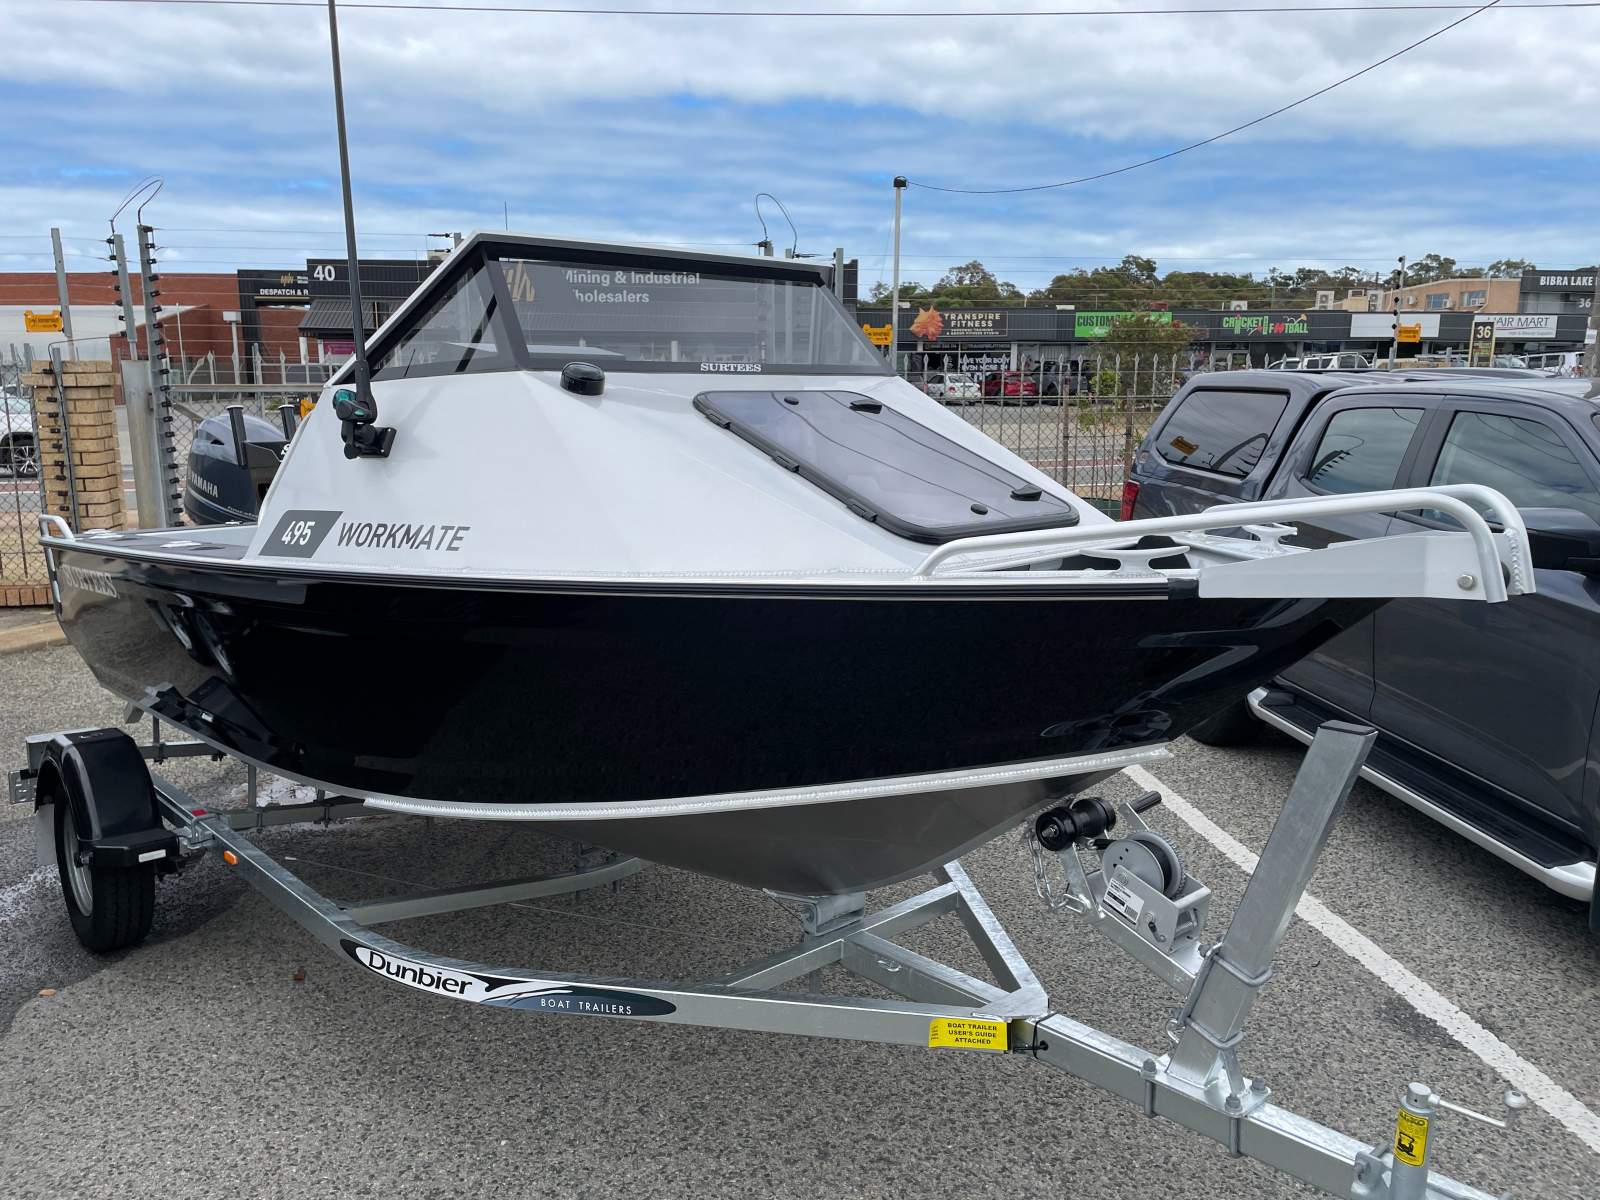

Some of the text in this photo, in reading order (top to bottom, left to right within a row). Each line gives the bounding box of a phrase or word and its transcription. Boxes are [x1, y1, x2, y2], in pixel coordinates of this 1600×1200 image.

[313, 265, 336, 281] 40
[615, 271, 627, 284] &
[631, 271, 700, 284] Industrial
[1540, 276, 1593, 286] BIBRA LAKE
[574, 289, 650, 303] holesalers
[1578, 298, 1592, 308] 36
[944, 312, 1001, 320] TRANSPIRE
[951, 320, 993, 328] FITNESS
[1517, 317, 1550, 327] MART
[1477, 326, 1491, 339] 36
[700, 363, 762, 372] SURTEES
[192, 471, 219, 498] YAMAHA
[281, 520, 471, 552] 495 WORKMATE
[368, 950, 473, 995] Dunbier
[541, 998, 633, 1015] BOAT TRAILERS
[968, 1023, 997, 1031] TRAILER
[954, 1037, 992, 1045] ATTACHED
